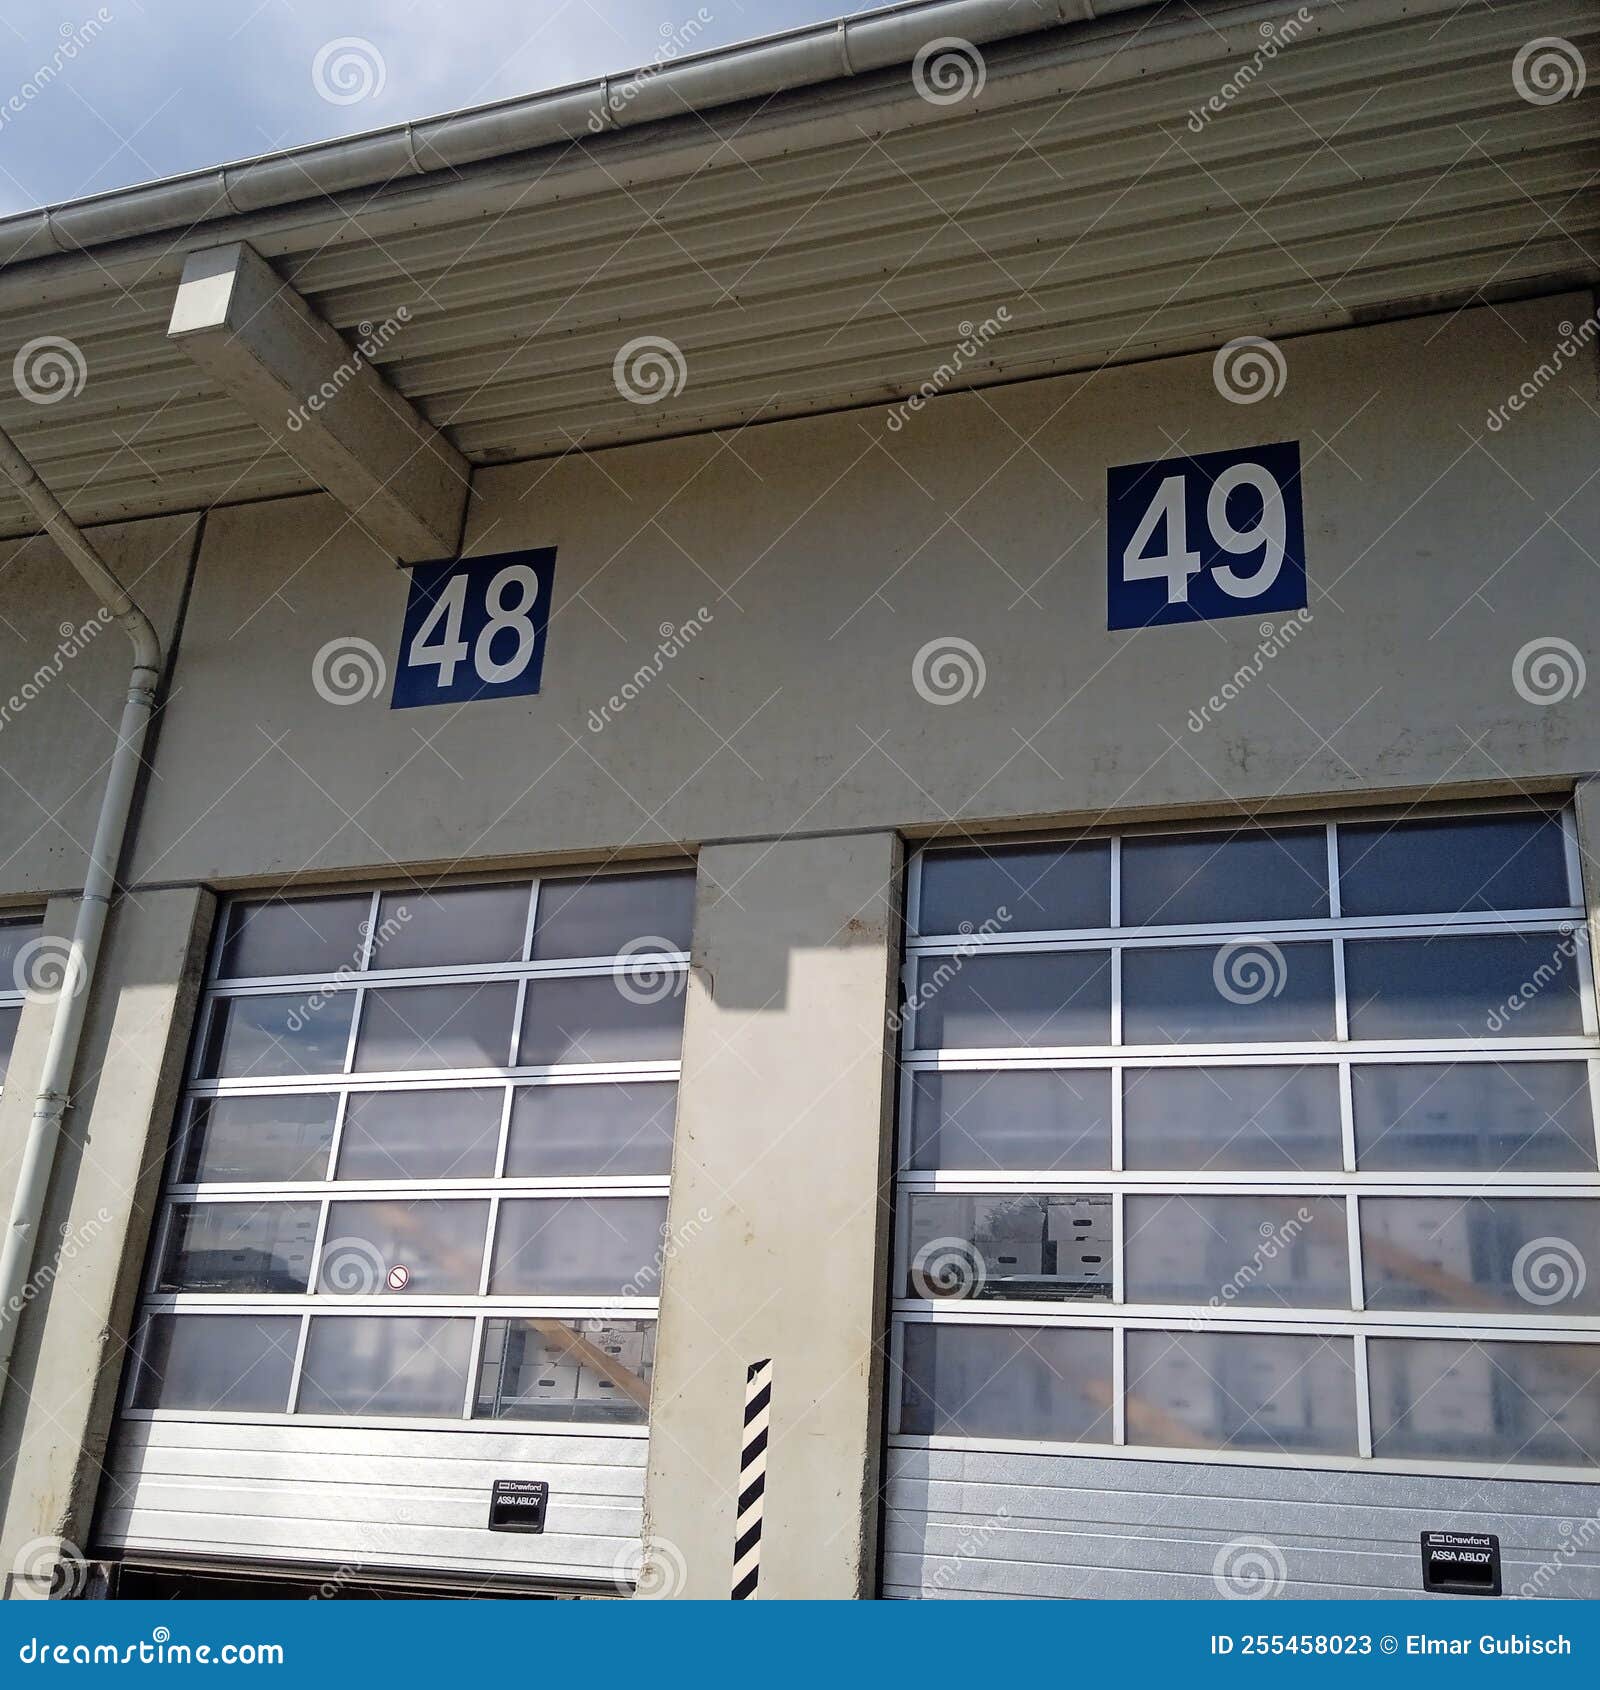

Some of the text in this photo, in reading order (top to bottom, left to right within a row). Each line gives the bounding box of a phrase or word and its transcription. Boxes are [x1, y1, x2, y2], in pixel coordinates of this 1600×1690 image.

[1123, 462, 1287, 604] 49
[407, 564, 538, 688] 48
[496, 1495, 540, 1506] ASSA ABLOY
[1445, 1534, 1490, 1546] Crawford
[1431, 1550, 1491, 1563] ASSA ABLOY
